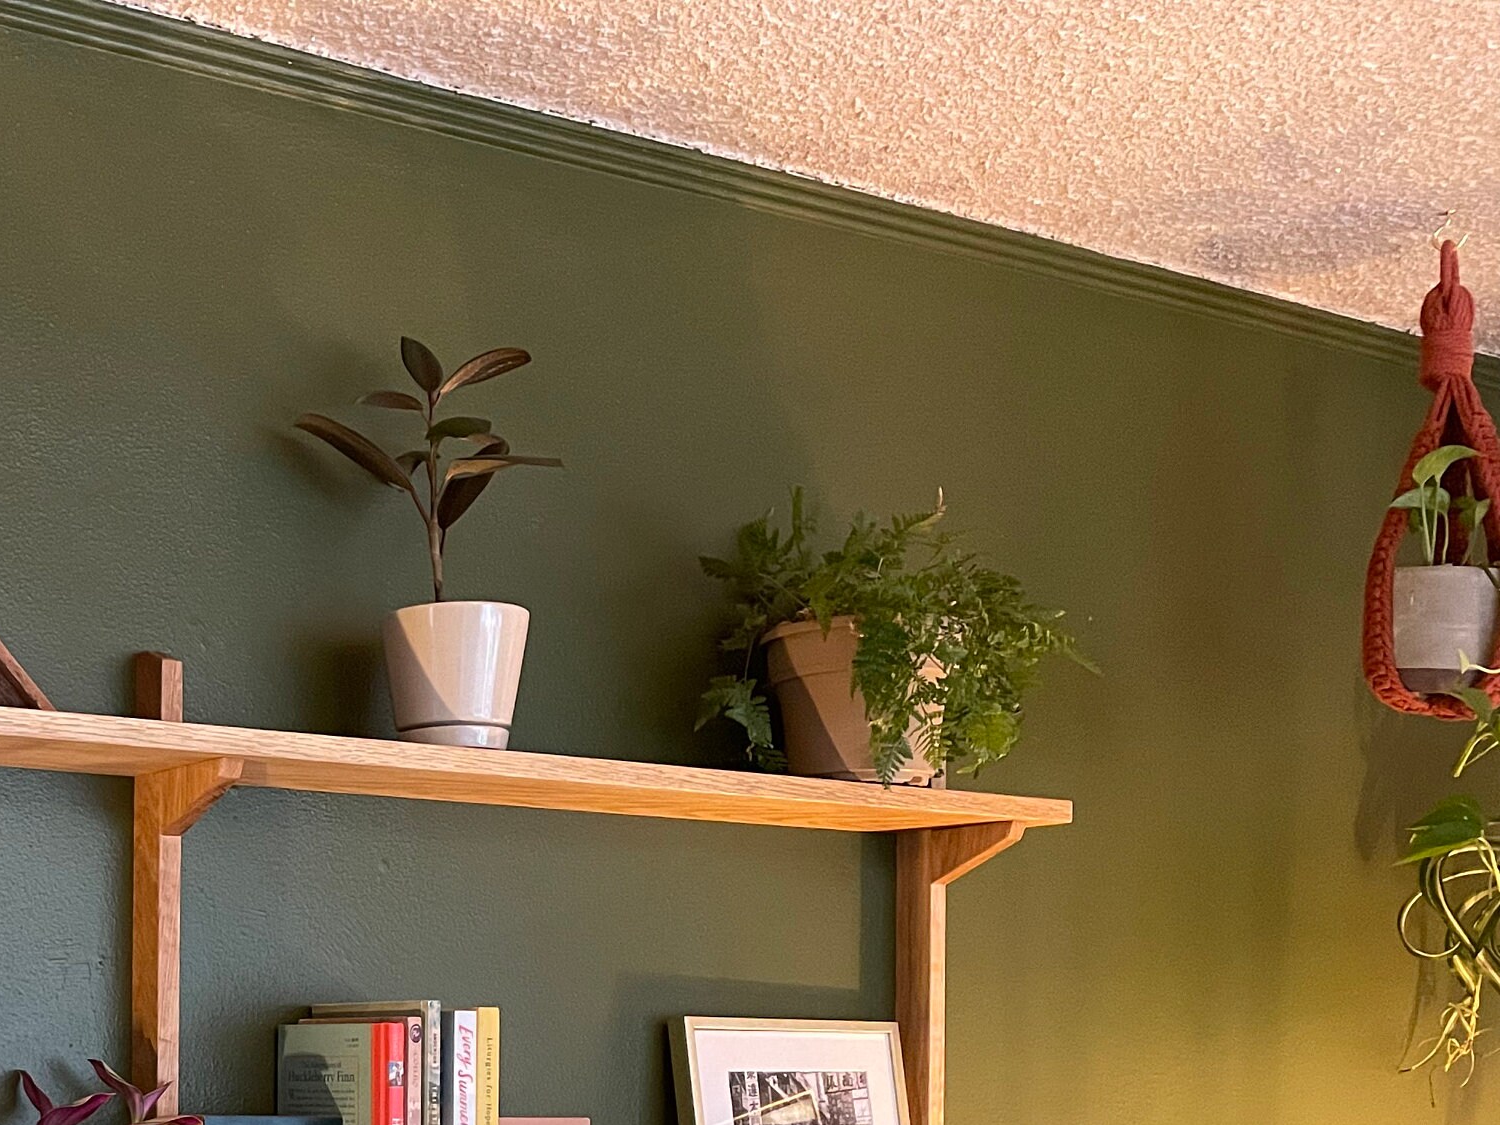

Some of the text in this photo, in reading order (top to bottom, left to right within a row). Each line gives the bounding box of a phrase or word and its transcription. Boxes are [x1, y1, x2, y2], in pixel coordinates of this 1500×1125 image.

[456, 1025, 474, 1069] Every
[485, 1037, 494, 1081] Liturgies
[337, 1070, 355, 1082] Finn
